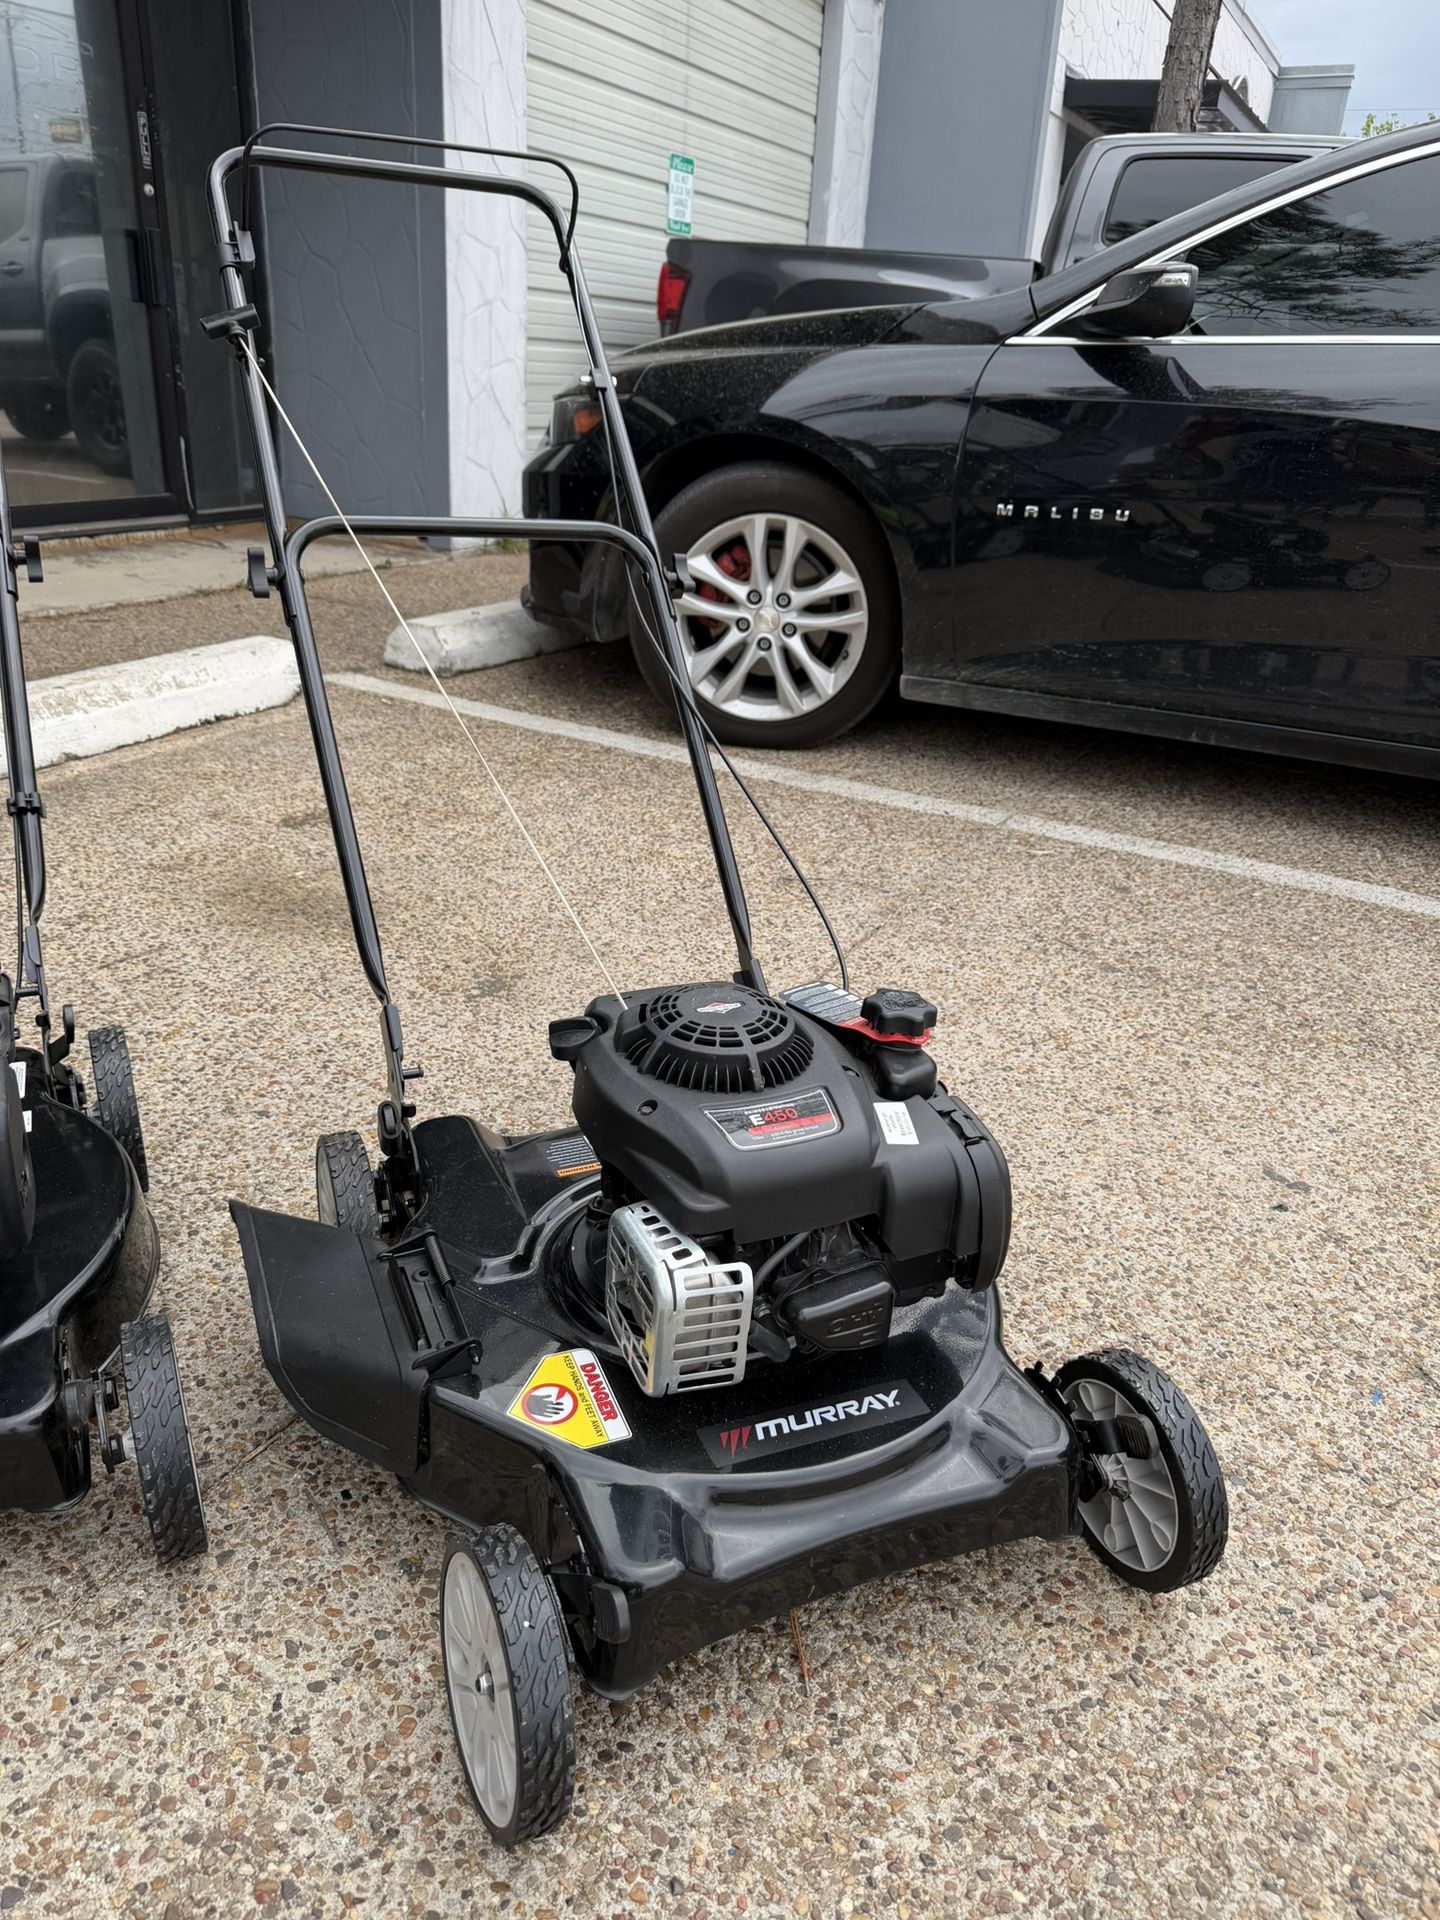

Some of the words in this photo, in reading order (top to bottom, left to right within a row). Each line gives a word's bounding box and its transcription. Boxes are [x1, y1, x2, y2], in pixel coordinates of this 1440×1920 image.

[140, 117, 149, 155] PULL
[672, 156, 693, 172] Please
[996, 502, 1130, 522] MALIBU
[748, 1107, 798, 1126] E450
[564, 1355, 575, 1370] KEEP
[571, 1371, 584, 1391] HANDS
[578, 1391, 589, 1403] and
[585, 1402, 596, 1419] FEET
[591, 1420, 605, 1437] AWAY
[580, 1362, 618, 1421] DANGER
[755, 1389, 900, 1440] MURRAY
